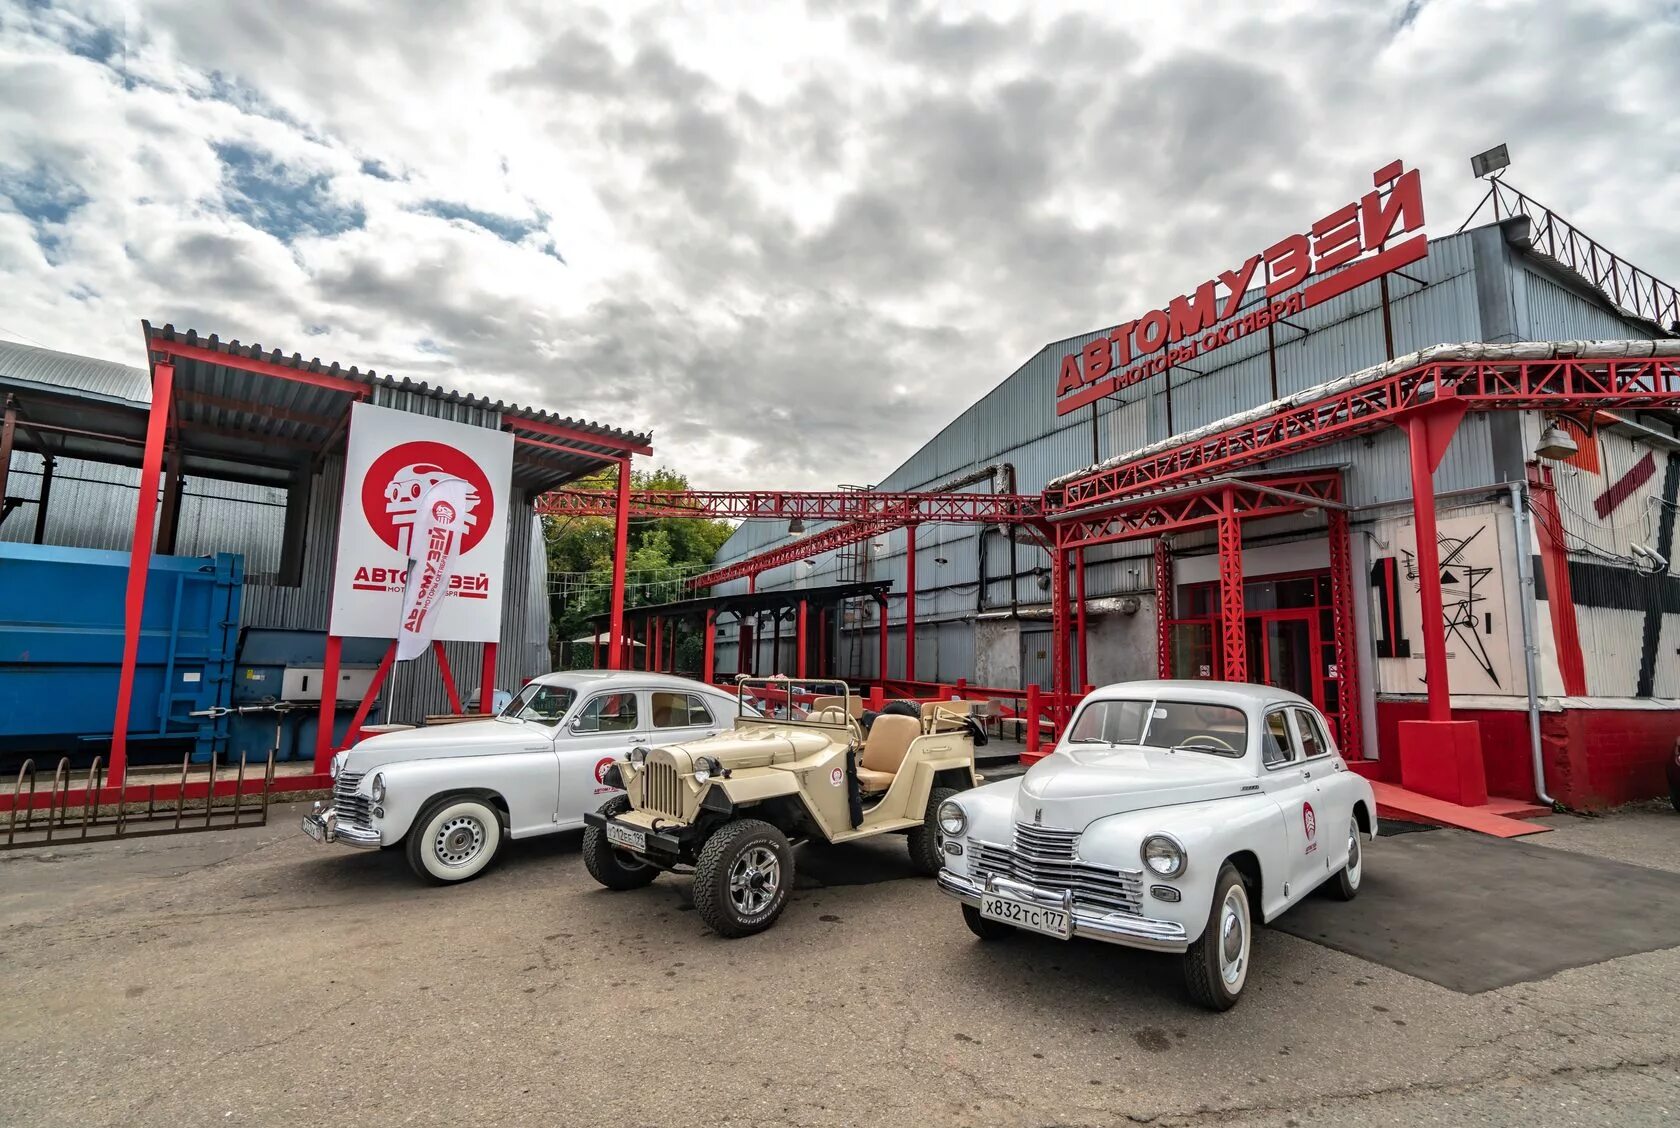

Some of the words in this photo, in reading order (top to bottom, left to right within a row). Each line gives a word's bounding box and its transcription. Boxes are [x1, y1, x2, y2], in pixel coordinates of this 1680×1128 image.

[1056, 159, 1425, 397] АВТОМУЗЕЙ
[1113, 340, 1198, 391] МОТОРЫ
[1201, 291, 1301, 351] ОКТЯБРЯ
[354, 566, 489, 591] АВТОЗЕЙ
[423, 582, 439, 609] МОТОРЫ
[986, 899, 1040, 926] Х832ТС
[1042, 910, 1064, 927] 177
